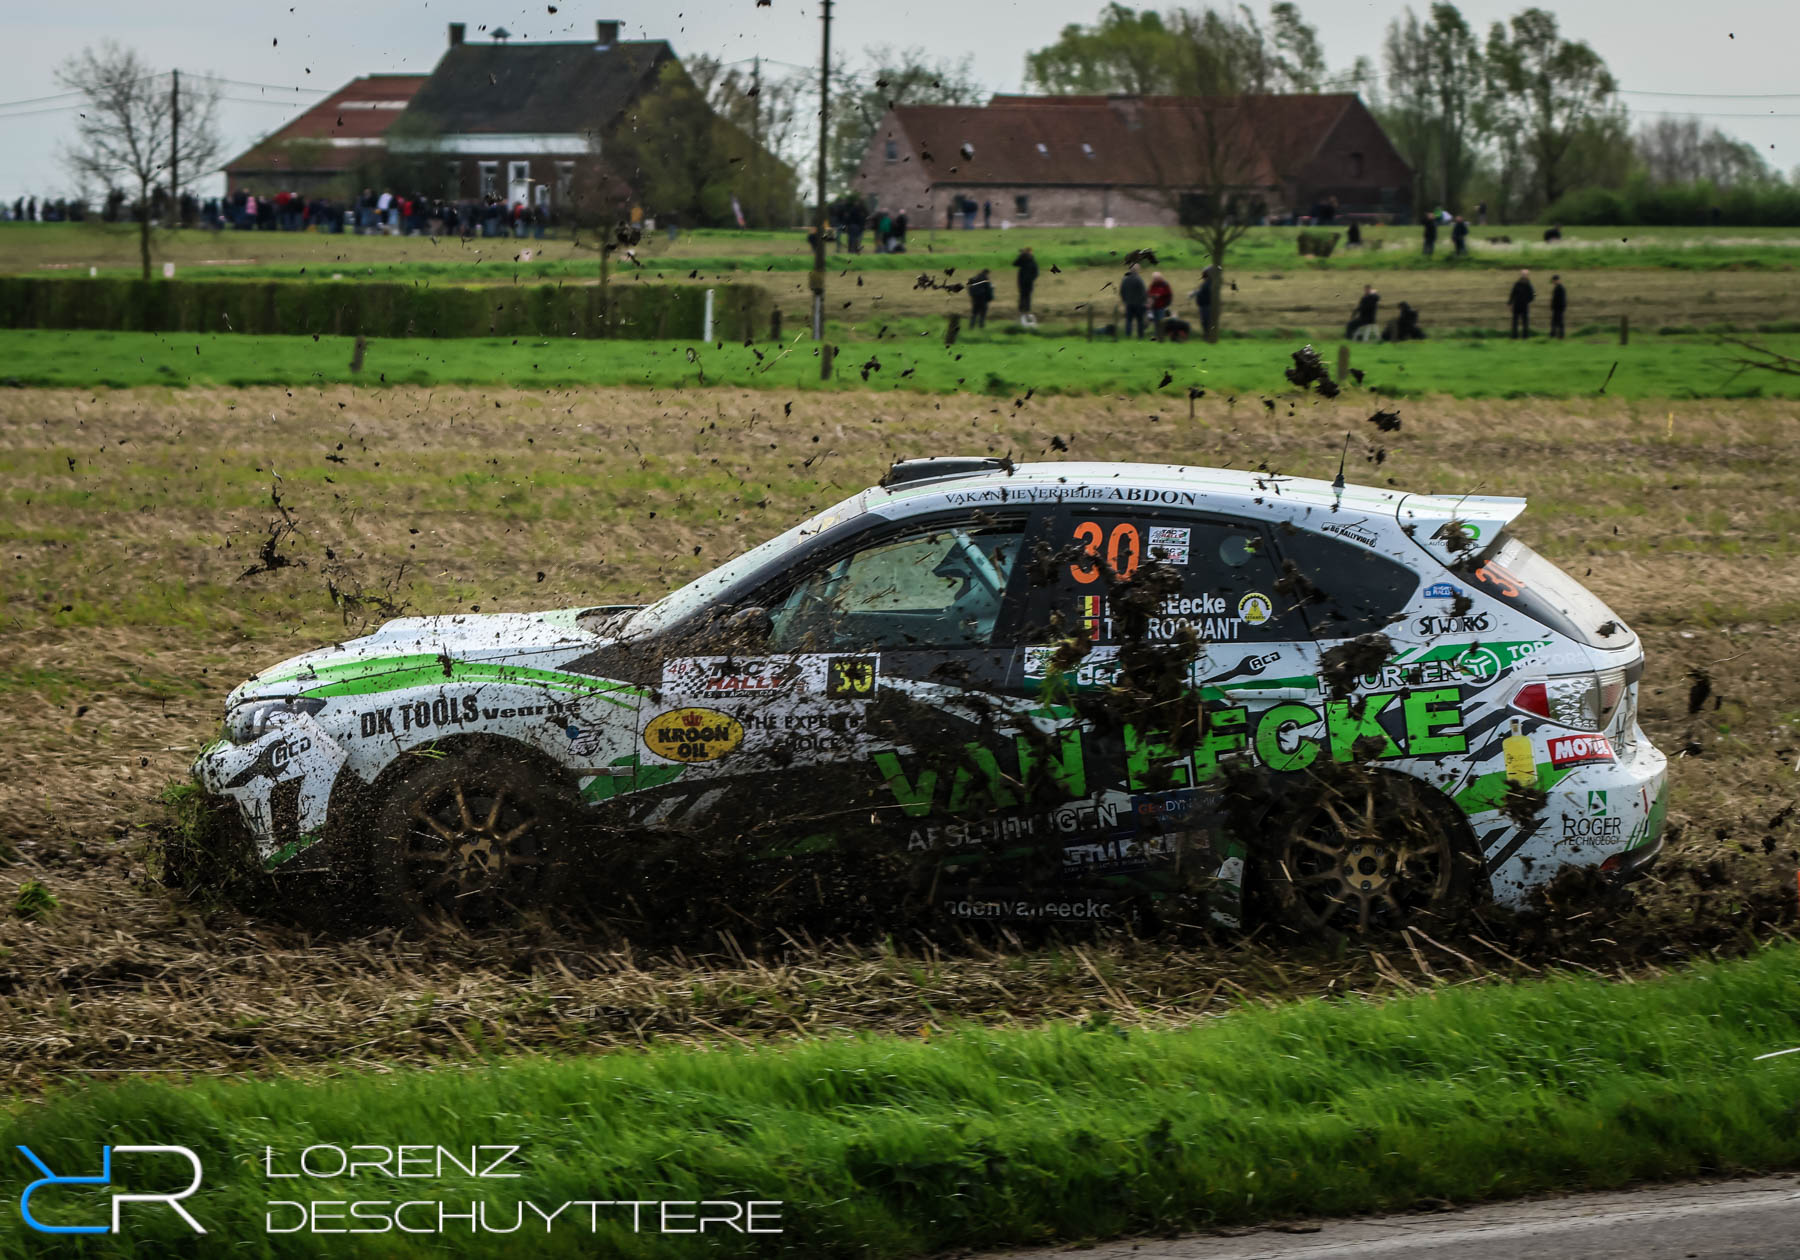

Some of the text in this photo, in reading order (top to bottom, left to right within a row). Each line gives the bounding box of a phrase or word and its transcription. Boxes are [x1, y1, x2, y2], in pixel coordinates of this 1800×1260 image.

[945, 487, 1101, 505] VAKANIEVERBLIJF
[1069, 521, 1140, 584] 30
[1507, 641, 1546, 659] TOP
[705, 676, 785, 690] RALLY
[360, 706, 394, 739] DK
[399, 694, 479, 731] TOOLS
[657, 725, 730, 744] KROON
[676, 742, 709, 759] OIL
[1554, 737, 1610, 760] MOTUL
[873, 728, 1086, 818] VAN
[1562, 817, 1621, 836] ROGER
[1562, 835, 1621, 847] TECHNOLOGY
